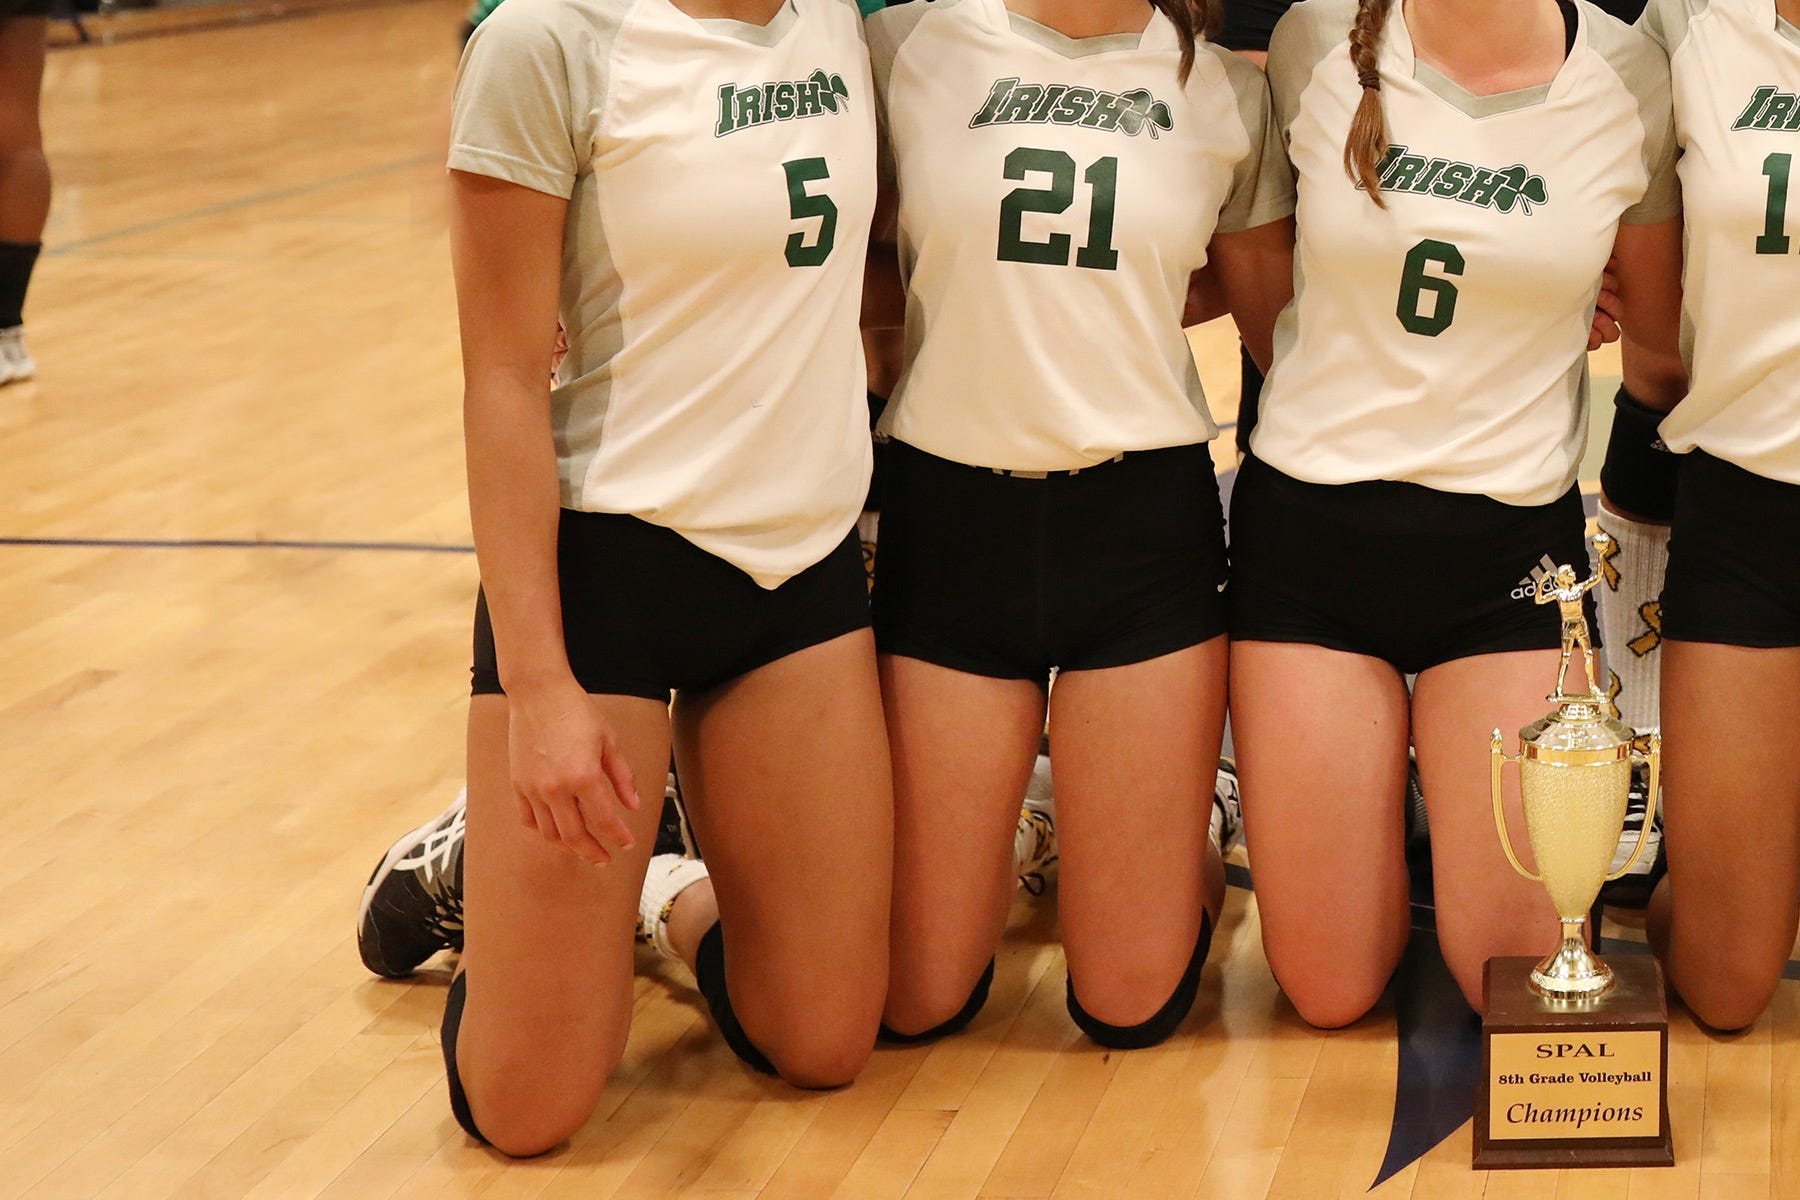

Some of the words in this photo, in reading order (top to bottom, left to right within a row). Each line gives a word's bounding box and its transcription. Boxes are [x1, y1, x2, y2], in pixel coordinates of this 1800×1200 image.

[715, 78, 828, 138] IRISH
[968, 77, 1136, 134] IRISH
[781, 157, 838, 267] 5
[997, 147, 1119, 271] 21
[1396, 238, 1465, 337] 6
[1498, 1073, 1524, 1085] 8th
[1529, 1073, 1575, 1084] Grade
[1578, 1071, 1652, 1086] Volleyball
[1535, 1043, 1615, 1059] SPAL
[1506, 1102, 1643, 1129] Champions
